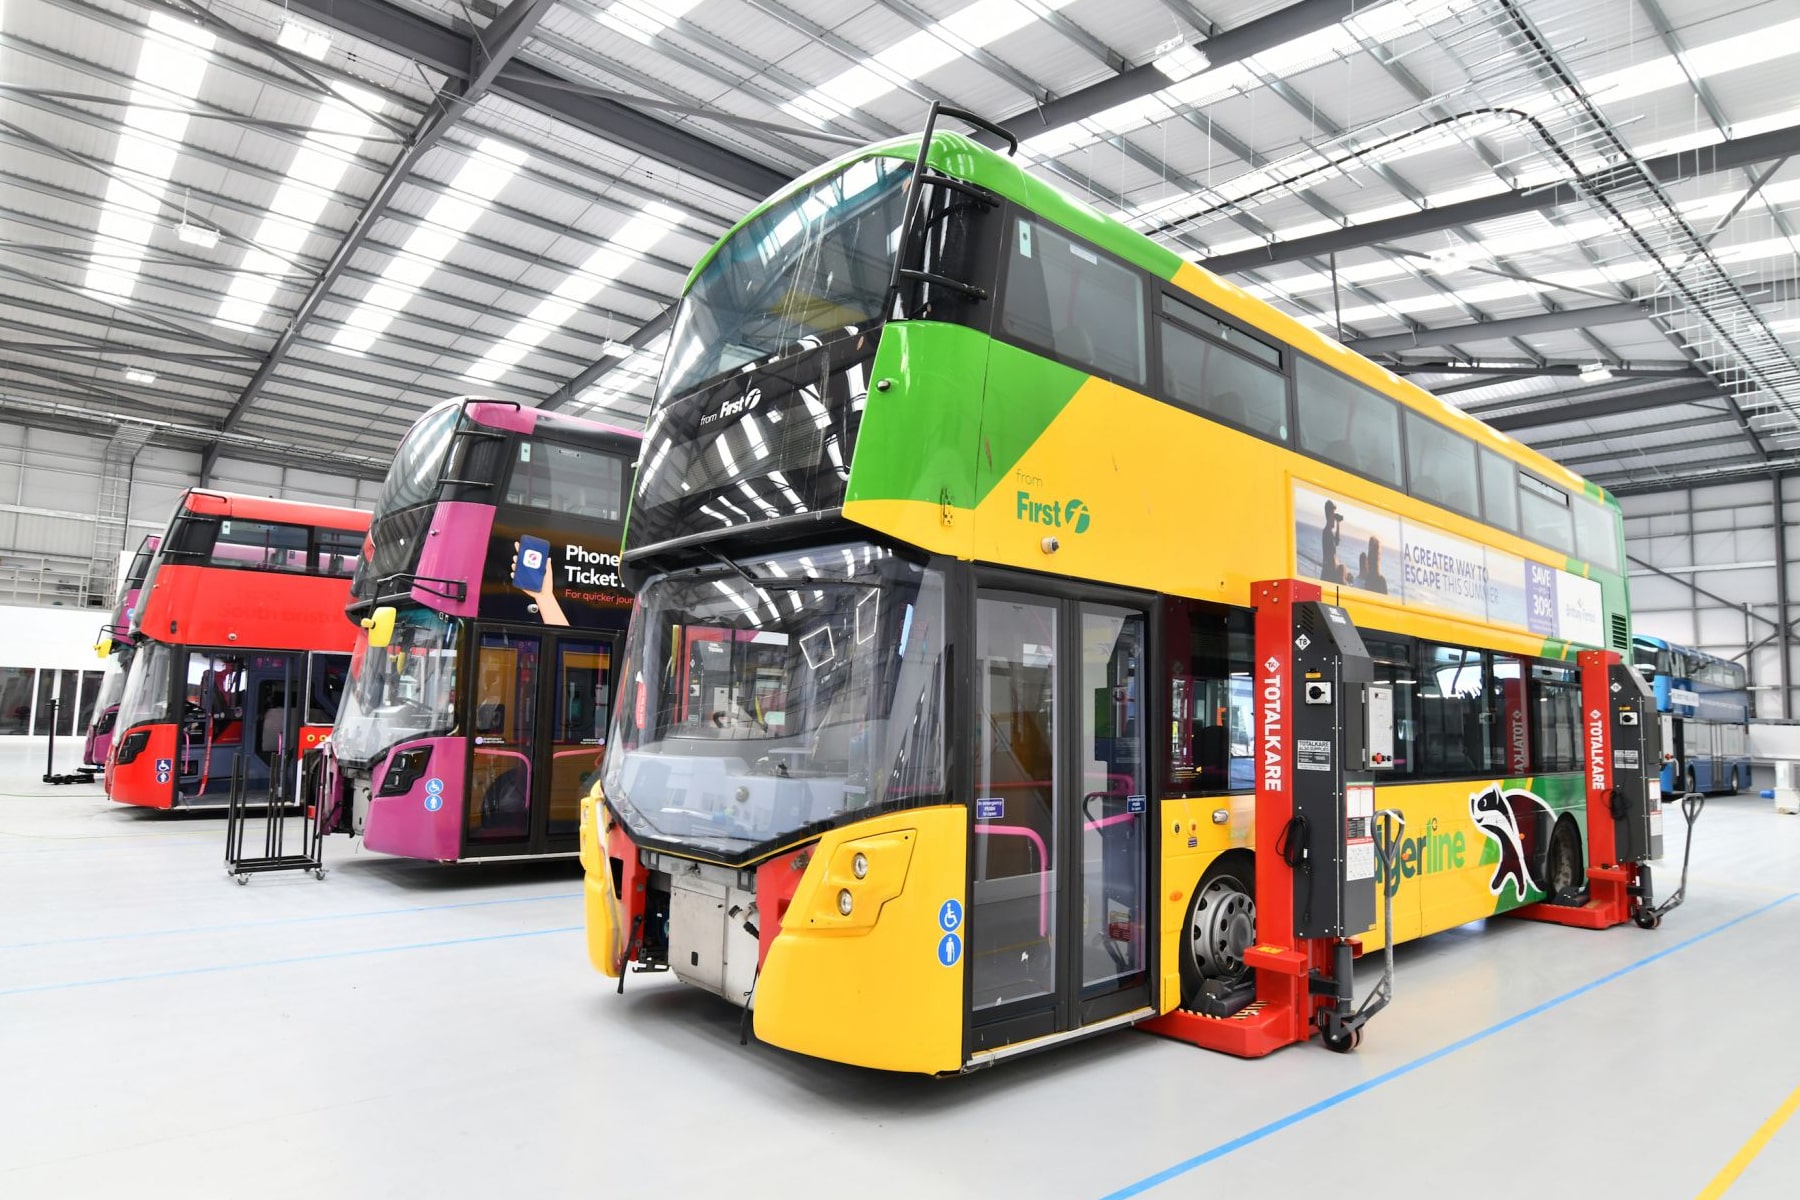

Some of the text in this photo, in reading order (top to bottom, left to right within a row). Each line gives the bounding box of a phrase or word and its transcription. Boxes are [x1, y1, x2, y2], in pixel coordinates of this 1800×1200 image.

[700, 396, 745, 426] from First
[1016, 468, 1043, 487] from
[1017, 490, 1061, 528] First
[565, 544, 620, 567] Phone
[1404, 543, 1489, 583] A GREATER WAY TO
[564, 565, 618, 588] Ticket
[1405, 564, 1441, 590] ESCAPE
[1442, 574, 1462, 595] THIS
[1532, 565, 1551, 587] SAVE
[565, 588, 633, 605] For quicker jour
[1533, 594, 1553, 618] 30%
[1264, 675, 1282, 792] TOTALKARE
[1590, 719, 1605, 790] TOTALKARE
